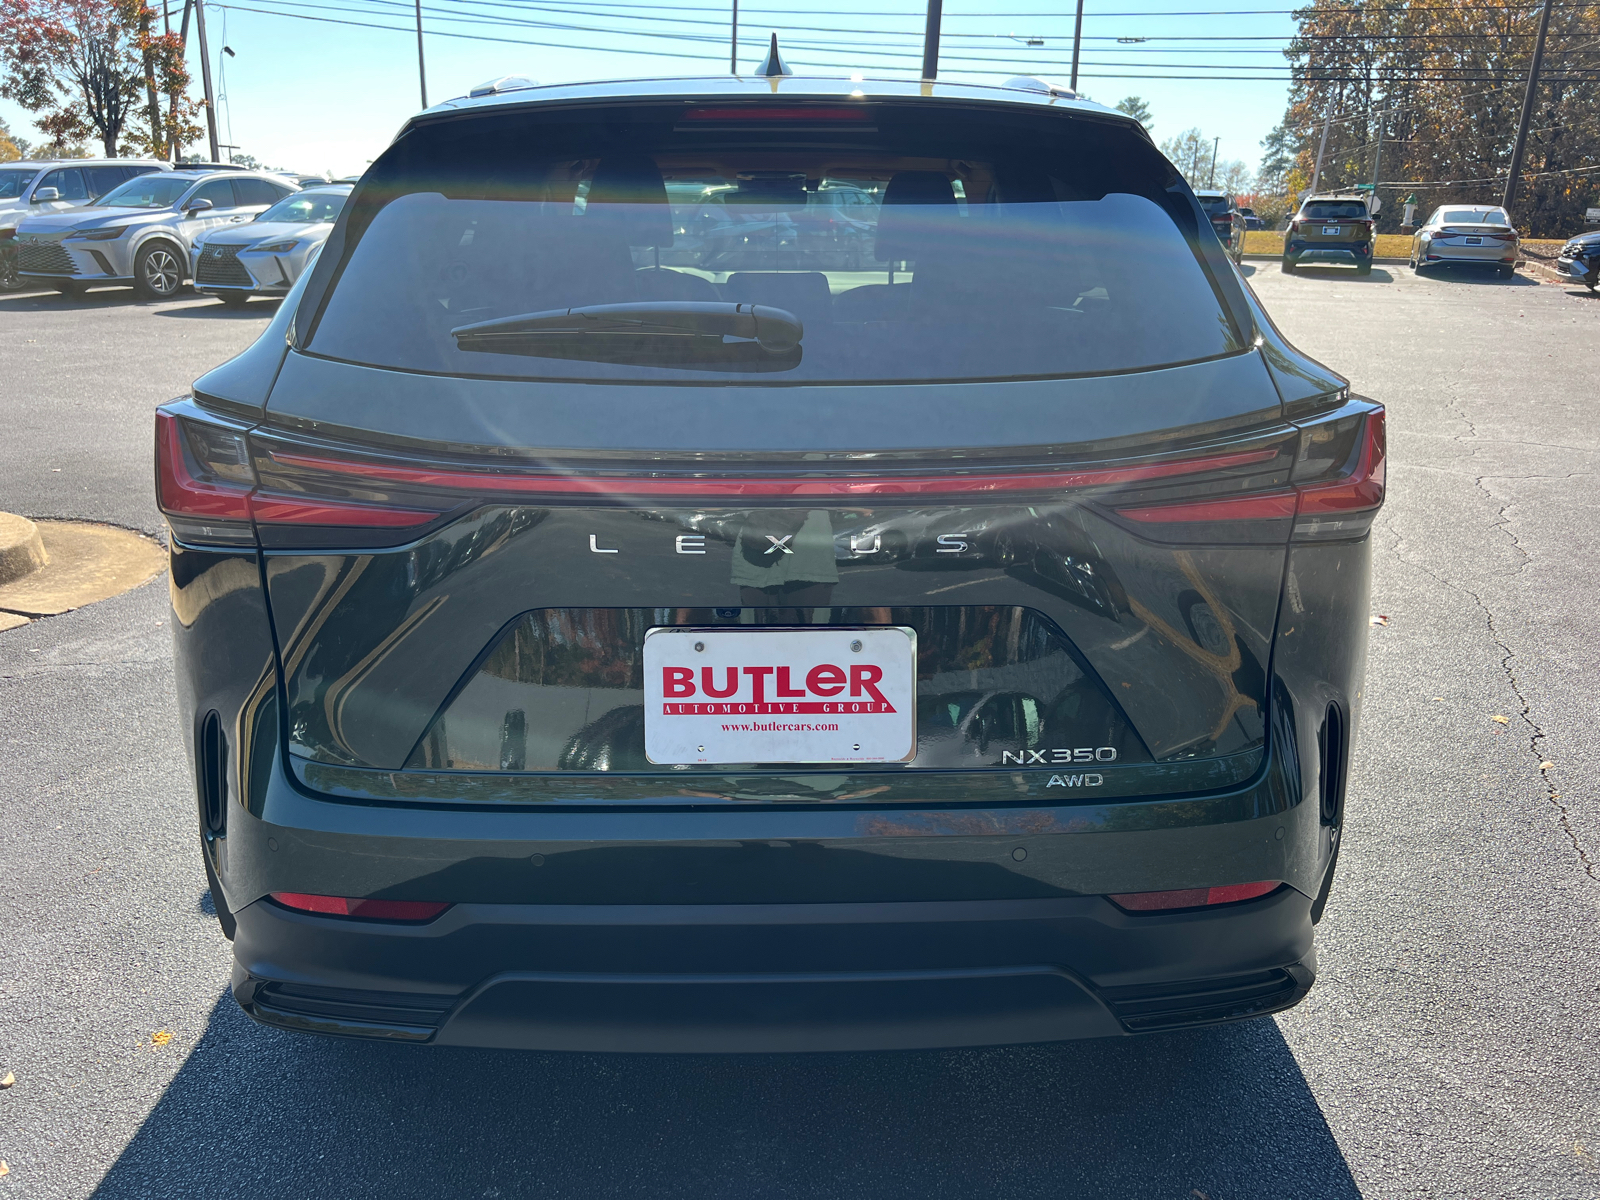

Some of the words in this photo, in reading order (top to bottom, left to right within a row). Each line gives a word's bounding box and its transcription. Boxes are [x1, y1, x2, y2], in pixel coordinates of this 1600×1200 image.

[589, 533, 969, 555] LEXUS
[664, 703, 799, 714] AUTOMOTIVE
[822, 703, 888, 713] GROUP
[721, 721, 839, 732] www.butlercars.com
[1002, 747, 1117, 764] NX350
[1046, 773, 1104, 788] AWD
